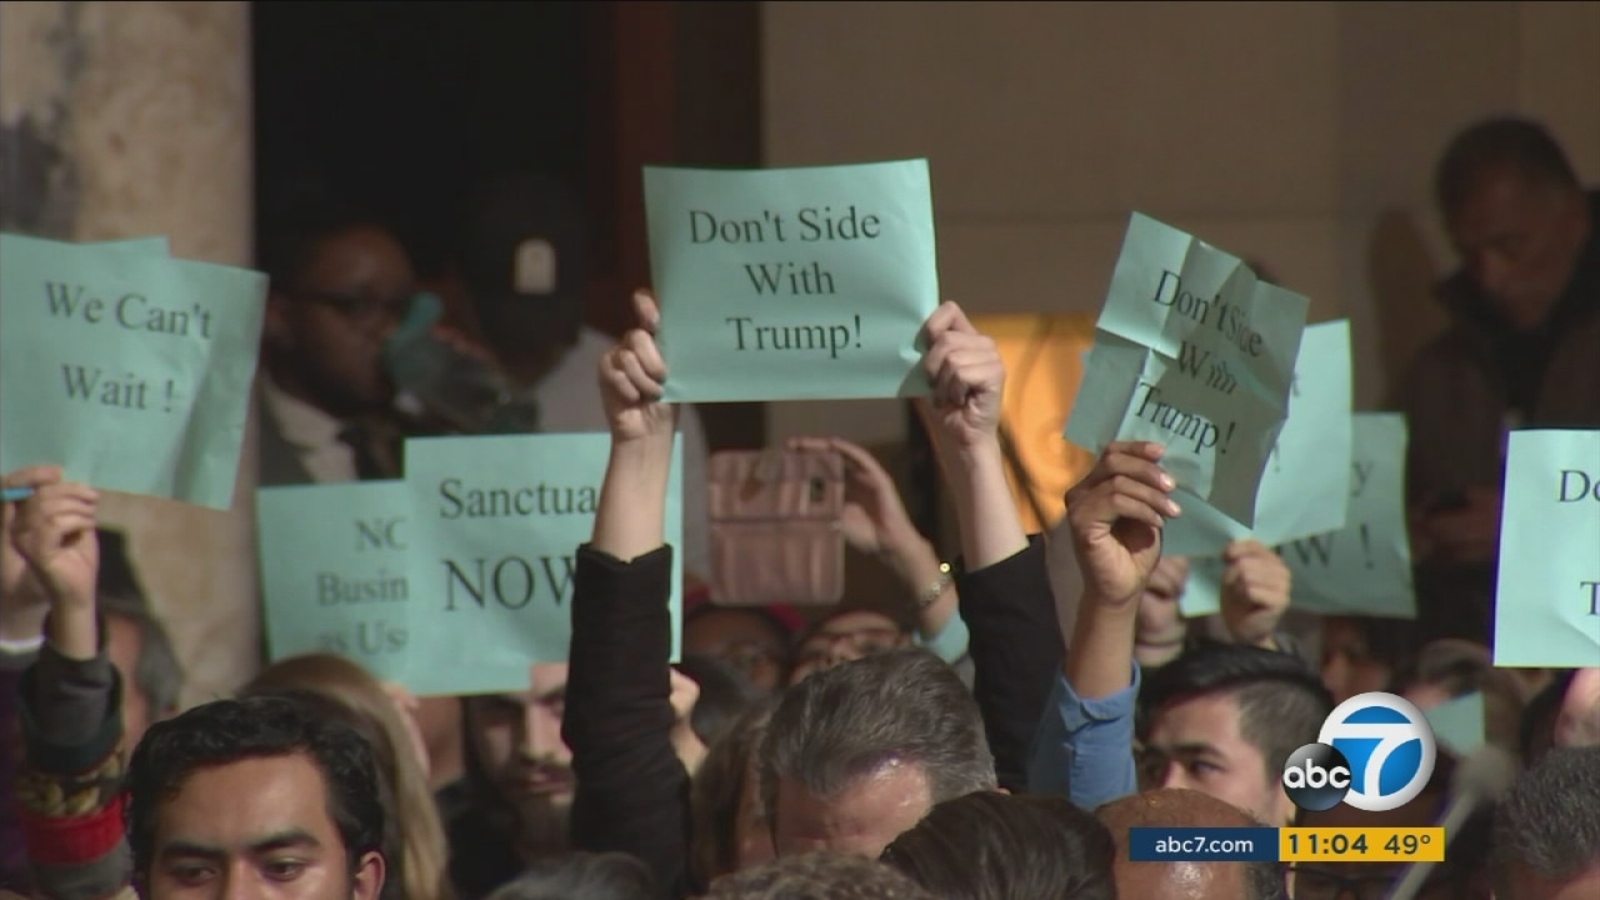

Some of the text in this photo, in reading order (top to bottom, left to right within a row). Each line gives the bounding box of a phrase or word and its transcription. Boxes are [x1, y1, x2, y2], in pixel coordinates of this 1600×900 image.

[689, 205, 881, 244] Don't Side
[744, 262, 836, 295] With
[1154, 270, 1227, 332] Don't
[46, 281, 212, 339] We Can't
[726, 314, 862, 358] Trump!
[61, 364, 147, 410] Wait
[1135, 381, 1236, 454] Trump!
